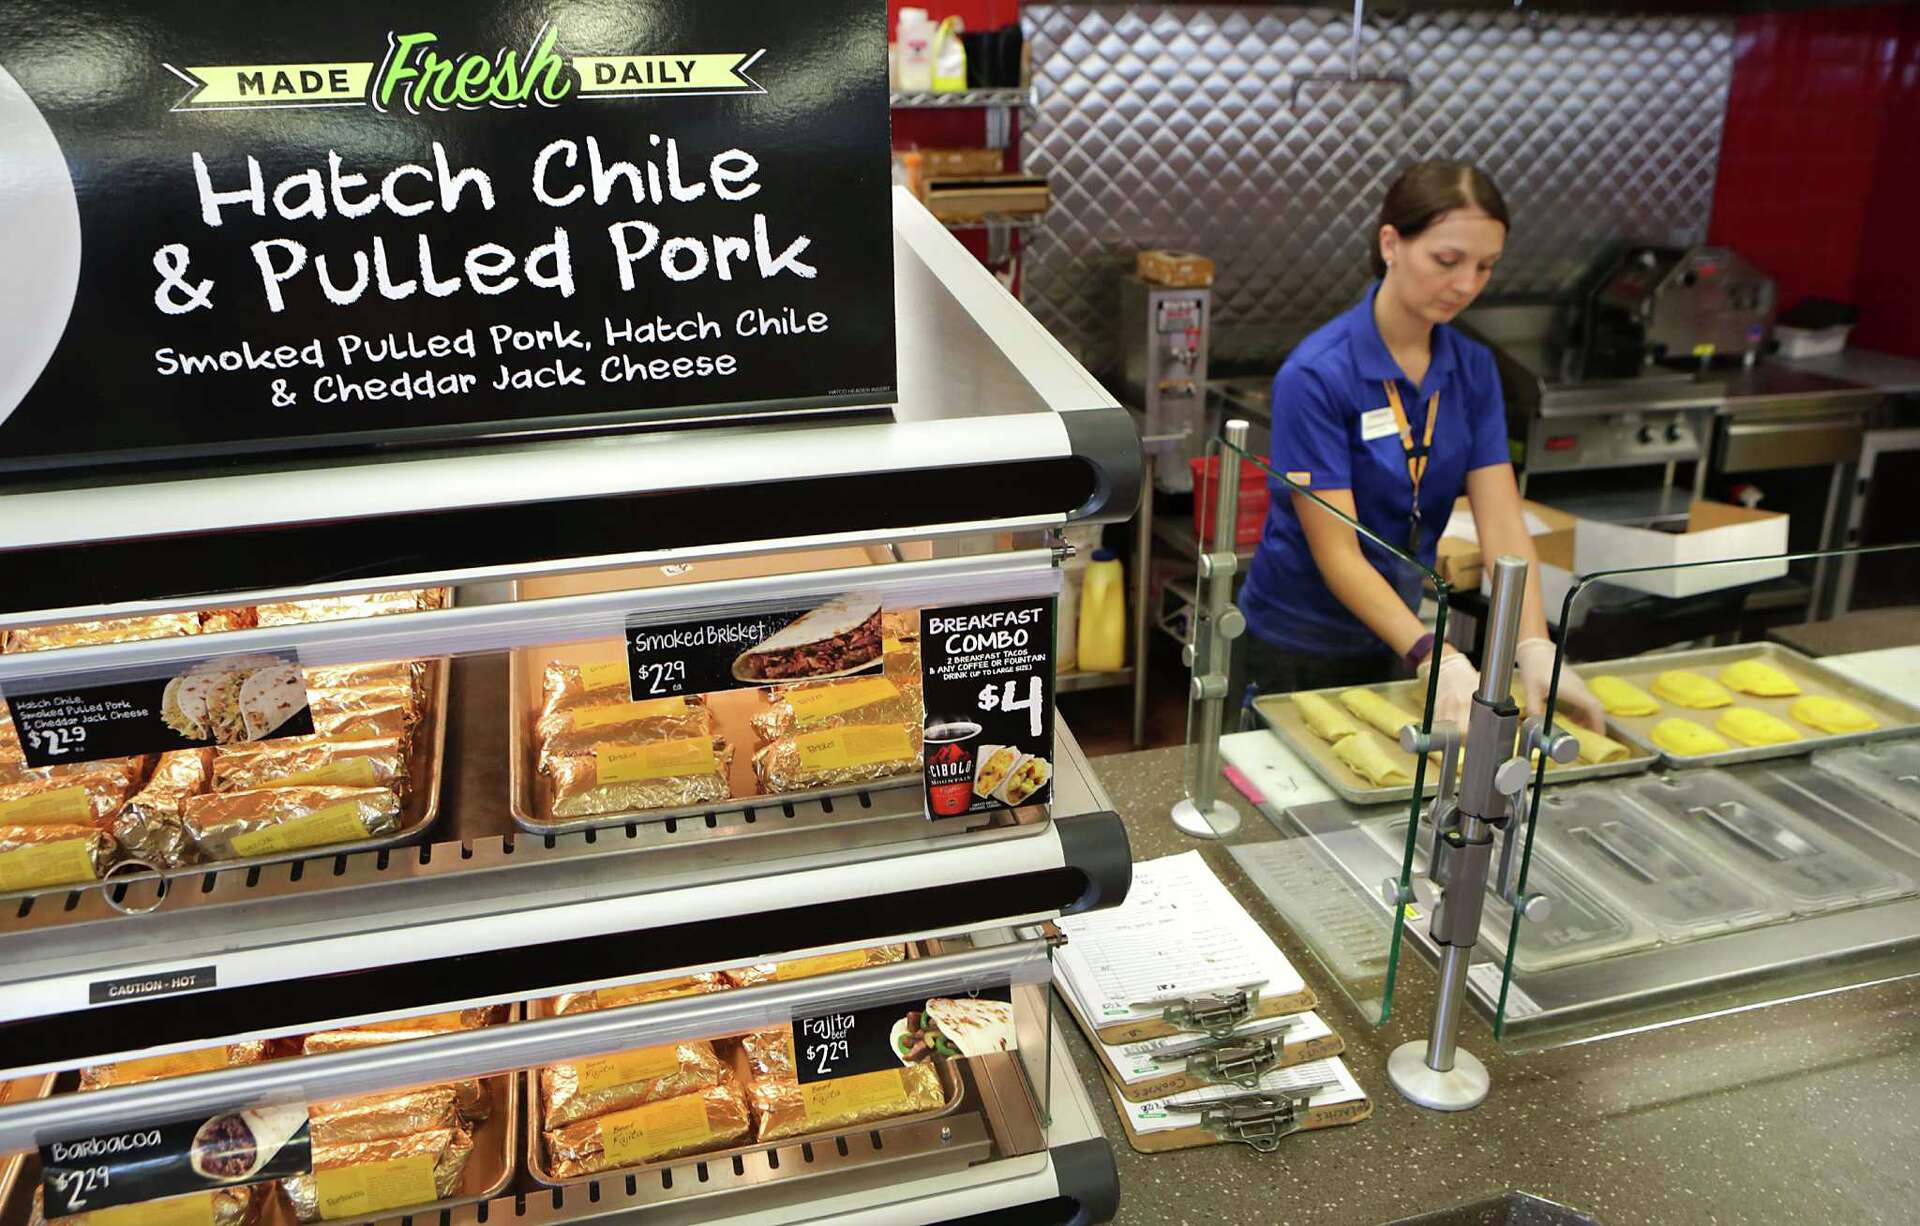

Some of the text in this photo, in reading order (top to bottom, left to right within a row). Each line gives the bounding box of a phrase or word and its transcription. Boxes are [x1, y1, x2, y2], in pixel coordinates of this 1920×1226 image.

[237, 23, 697, 108] MADE Fresh DAILY
[192, 134, 761, 227] Hatch Chile
[152, 213, 818, 315] & Pulled Pork
[155, 307, 829, 376] Smoked Pulled Pork, Hatch Chile
[270, 352, 738, 407] & Cheddar Jack Cheese
[929, 608, 1043, 635] BREAKFAST
[635, 626, 704, 652] Smoked
[945, 629, 1029, 654] COMBO
[937, 665, 955, 674] ANY
[957, 661, 989, 672] COFFEE
[991, 659, 1002, 667] OR
[1004, 654, 1046, 666] FOUNTAIN
[947, 649, 1028, 665] 2 BREAKFAST TACOS
[943, 672, 968, 681] DRINK
[993, 666, 1014, 675] LARGE
[16, 697, 51, 710] Hatch
[19, 700, 132, 721] Smoked Pulled Pork
[978, 675, 1043, 737] $4
[34, 718, 78, 730] Cheddar
[82, 714, 108, 724] Jack
[110, 709, 149, 720] Cheese
[929, 760, 972, 778] CIBOLO
[109, 980, 162, 997] CAUTION
[171, 975, 196, 988] HOT
[803, 1013, 855, 1039] Fajita
[52, 1129, 161, 1162] Barbacoa
